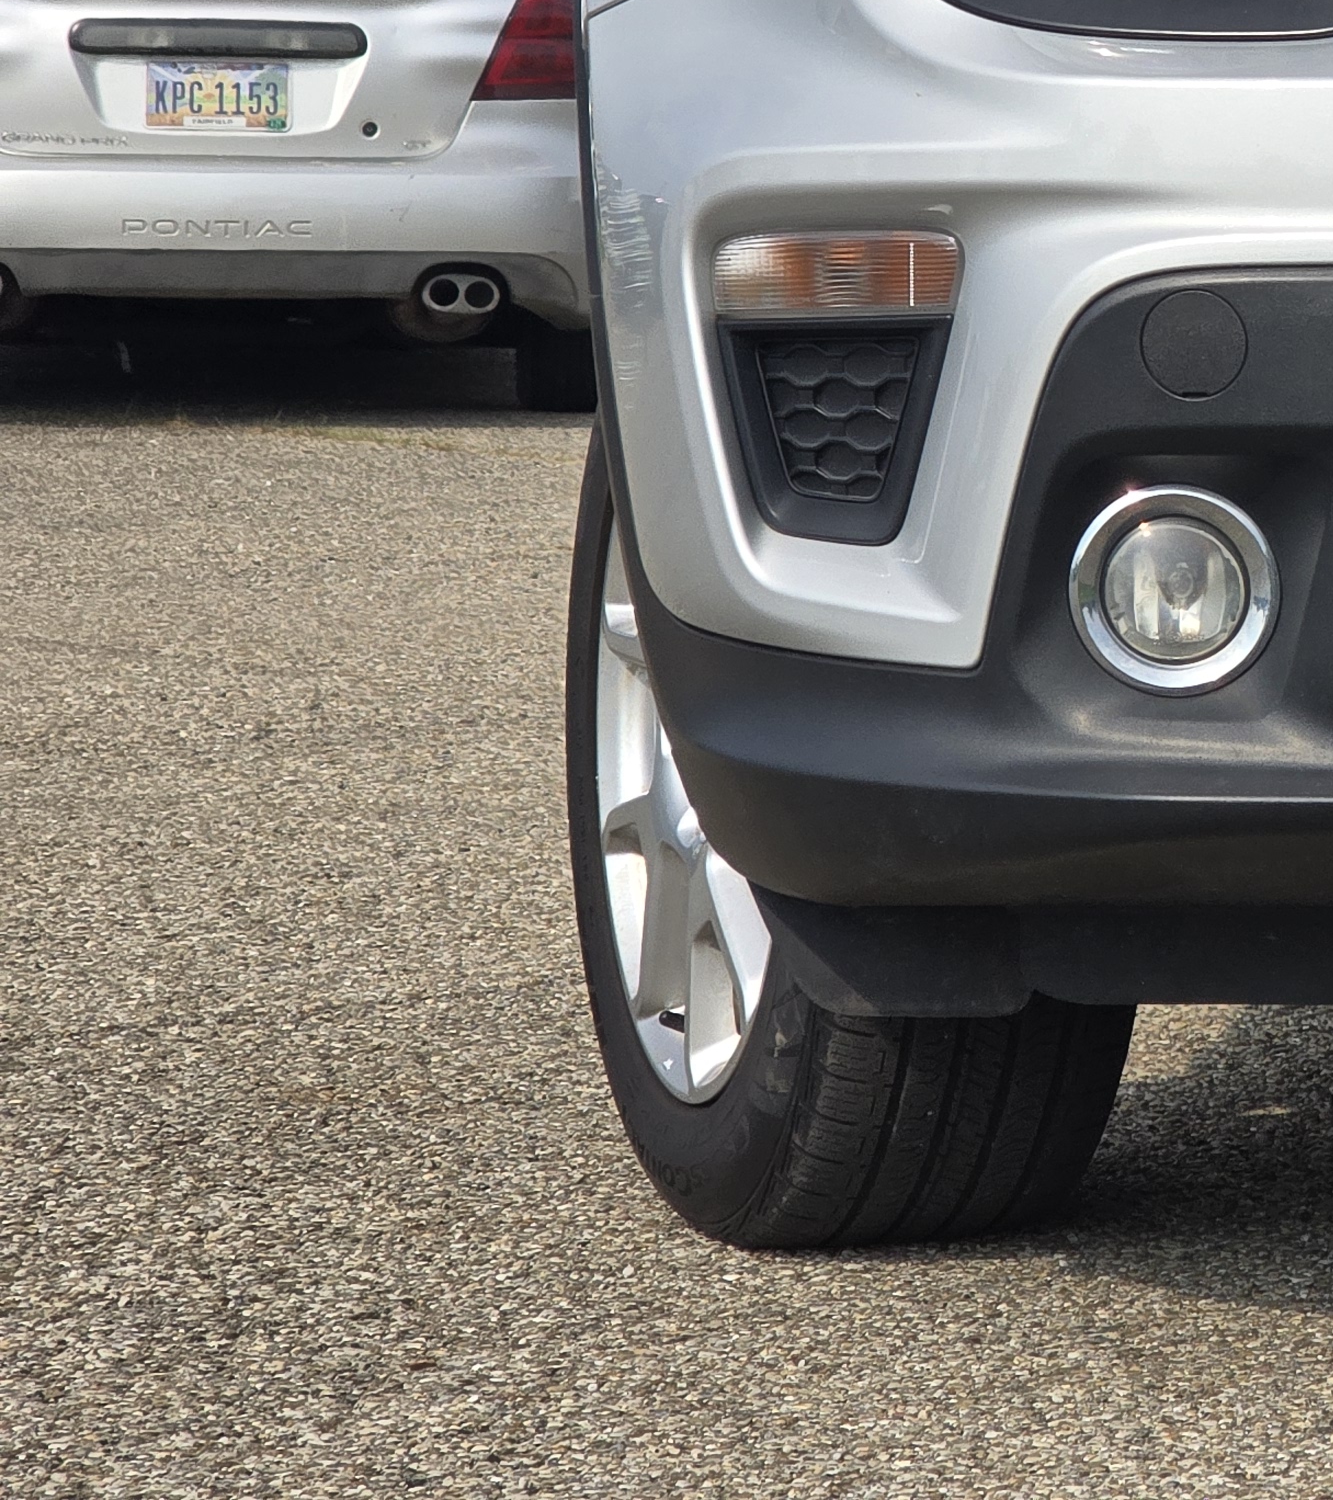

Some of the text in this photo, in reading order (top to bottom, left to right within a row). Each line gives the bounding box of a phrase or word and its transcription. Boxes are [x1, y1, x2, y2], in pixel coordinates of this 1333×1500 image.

[155, 80, 279, 116] KPC 1153
[121, 218, 313, 238] PONTIAC
